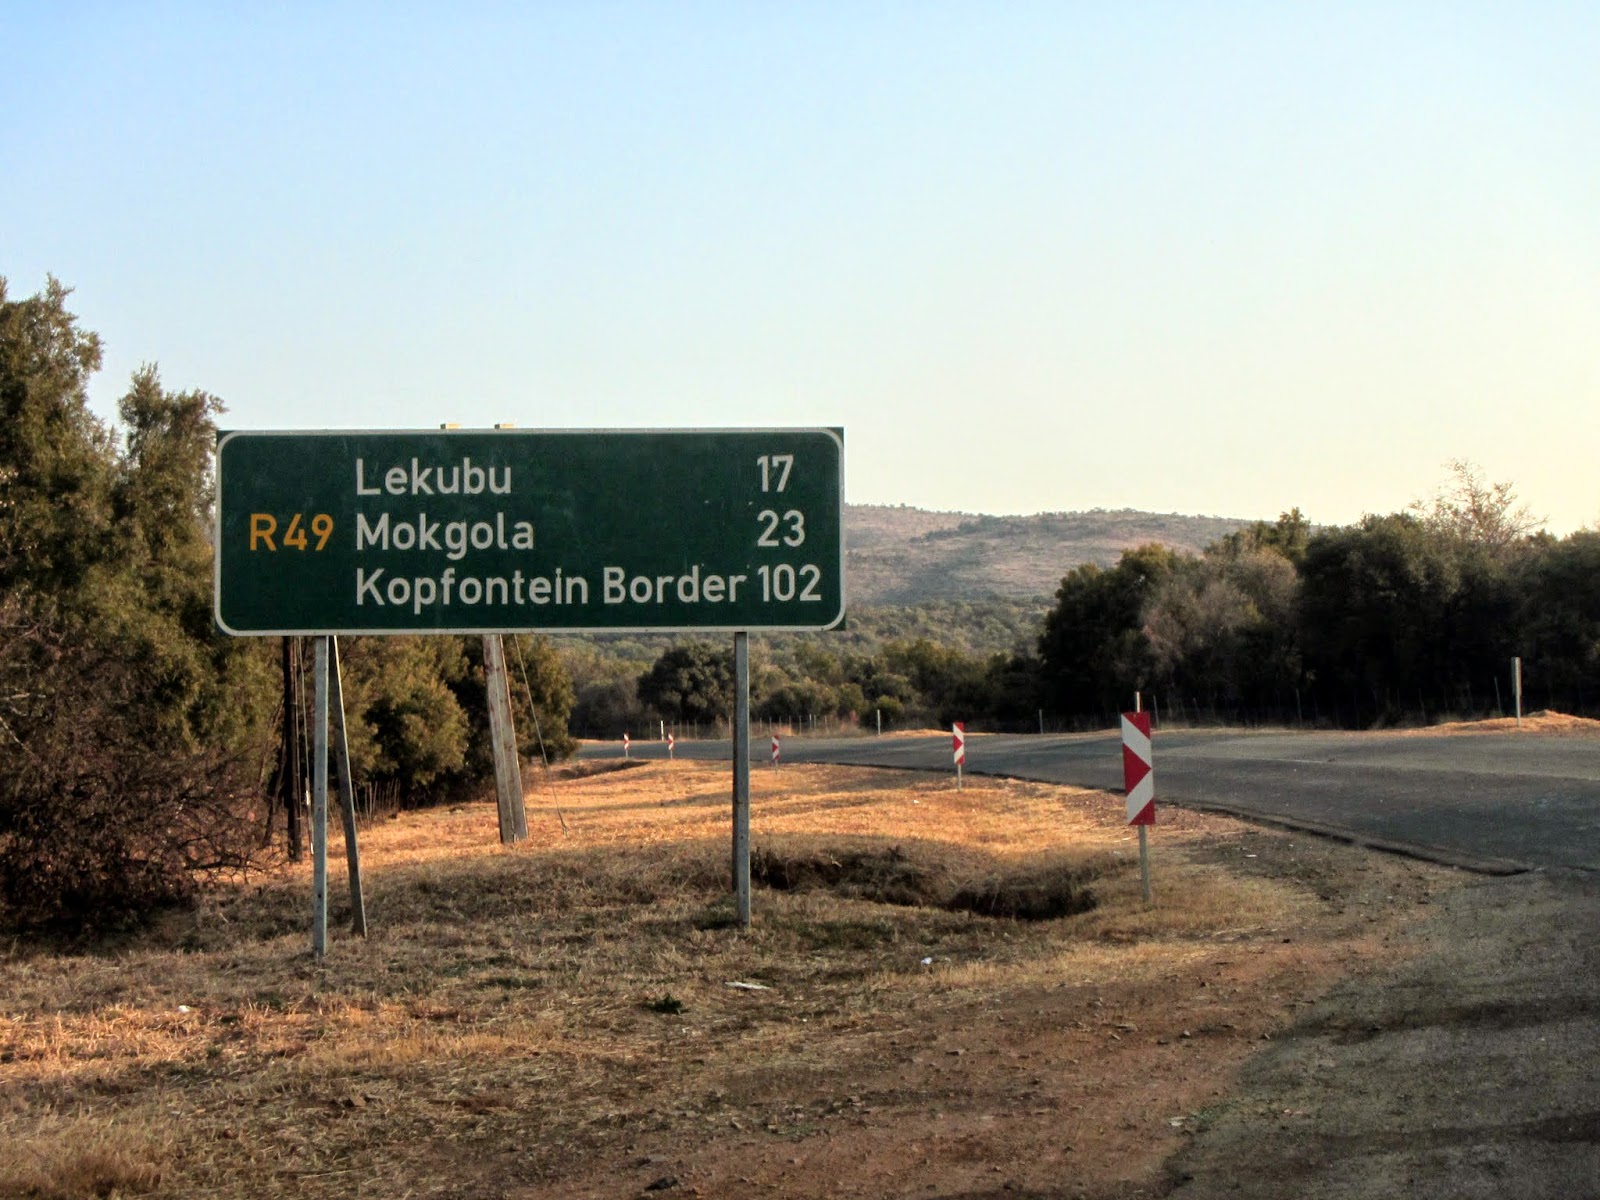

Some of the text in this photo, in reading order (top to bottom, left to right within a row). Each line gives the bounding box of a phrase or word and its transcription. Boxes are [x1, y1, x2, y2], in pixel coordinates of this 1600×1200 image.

[356, 457, 511, 495] Lekubu
[757, 454, 794, 492] 17
[249, 513, 334, 552] R49
[356, 512, 534, 560] Mokgola
[757, 509, 806, 547] 23
[356, 563, 822, 615] Kopfontein Border 102
